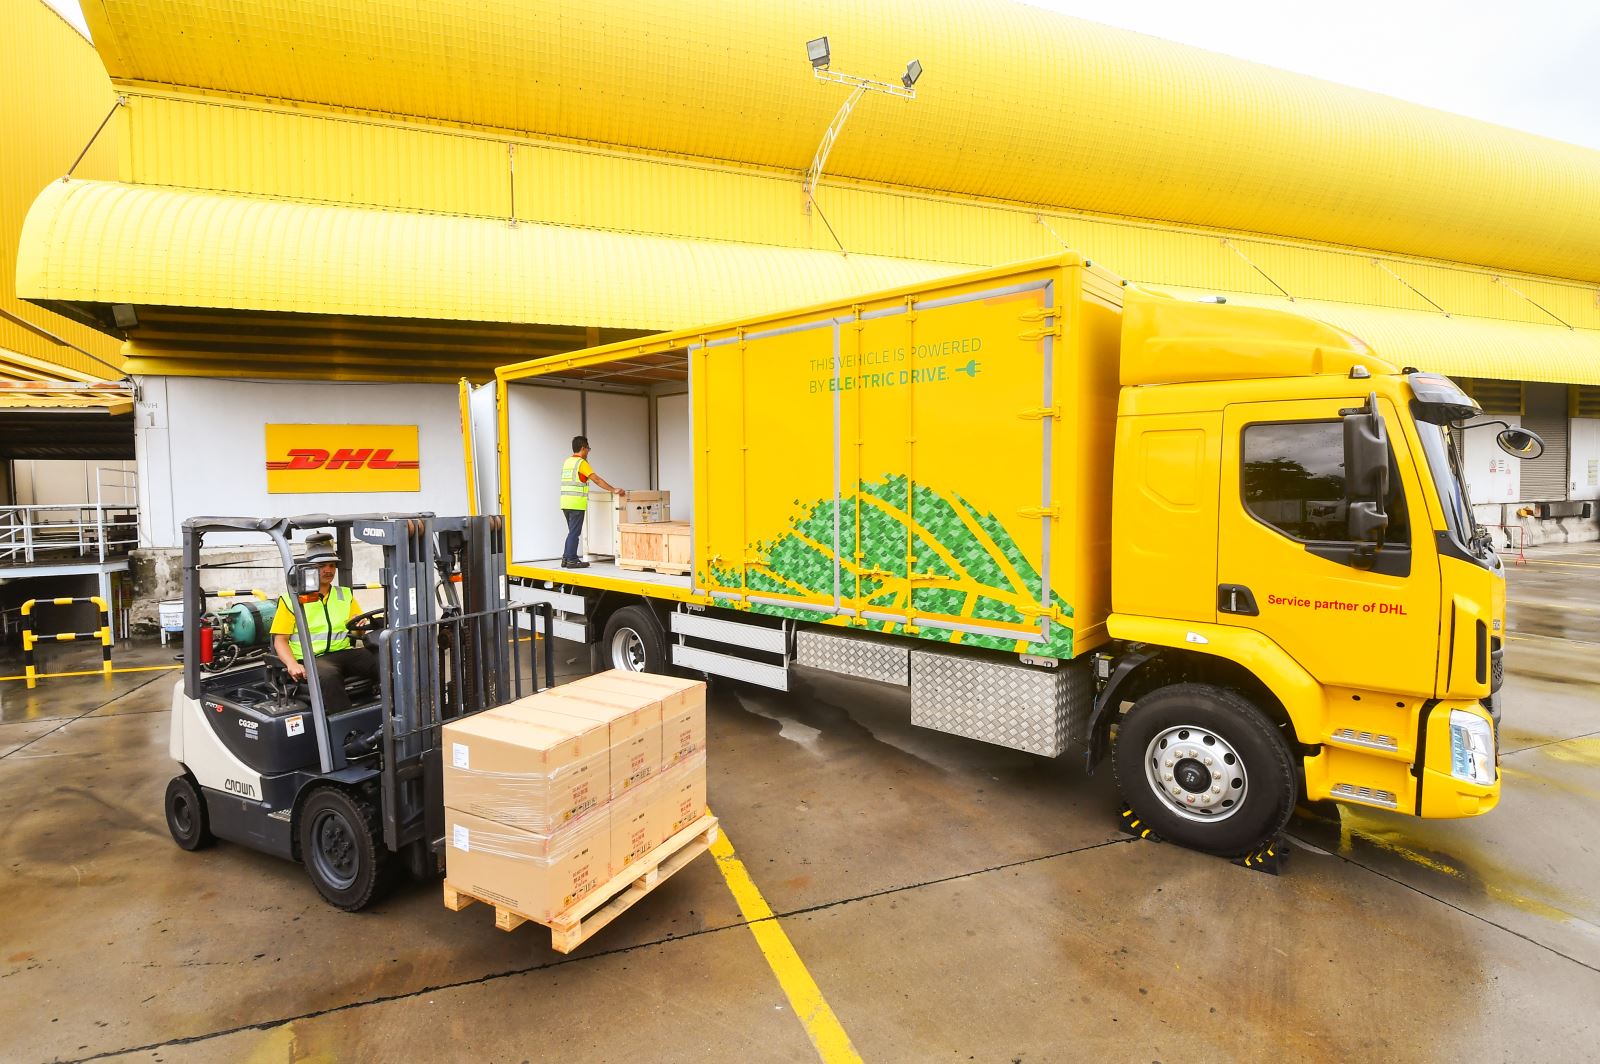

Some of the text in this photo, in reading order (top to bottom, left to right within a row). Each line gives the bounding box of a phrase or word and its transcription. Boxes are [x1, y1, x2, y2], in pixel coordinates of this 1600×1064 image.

[810, 337, 982, 372] THIS VEHICLE IS POWERED
[809, 379, 825, 393] BY
[146, 411, 156, 426] 1
[286, 448, 400, 470] DHL
[1267, 594, 1407, 616] Service partner of DHL
